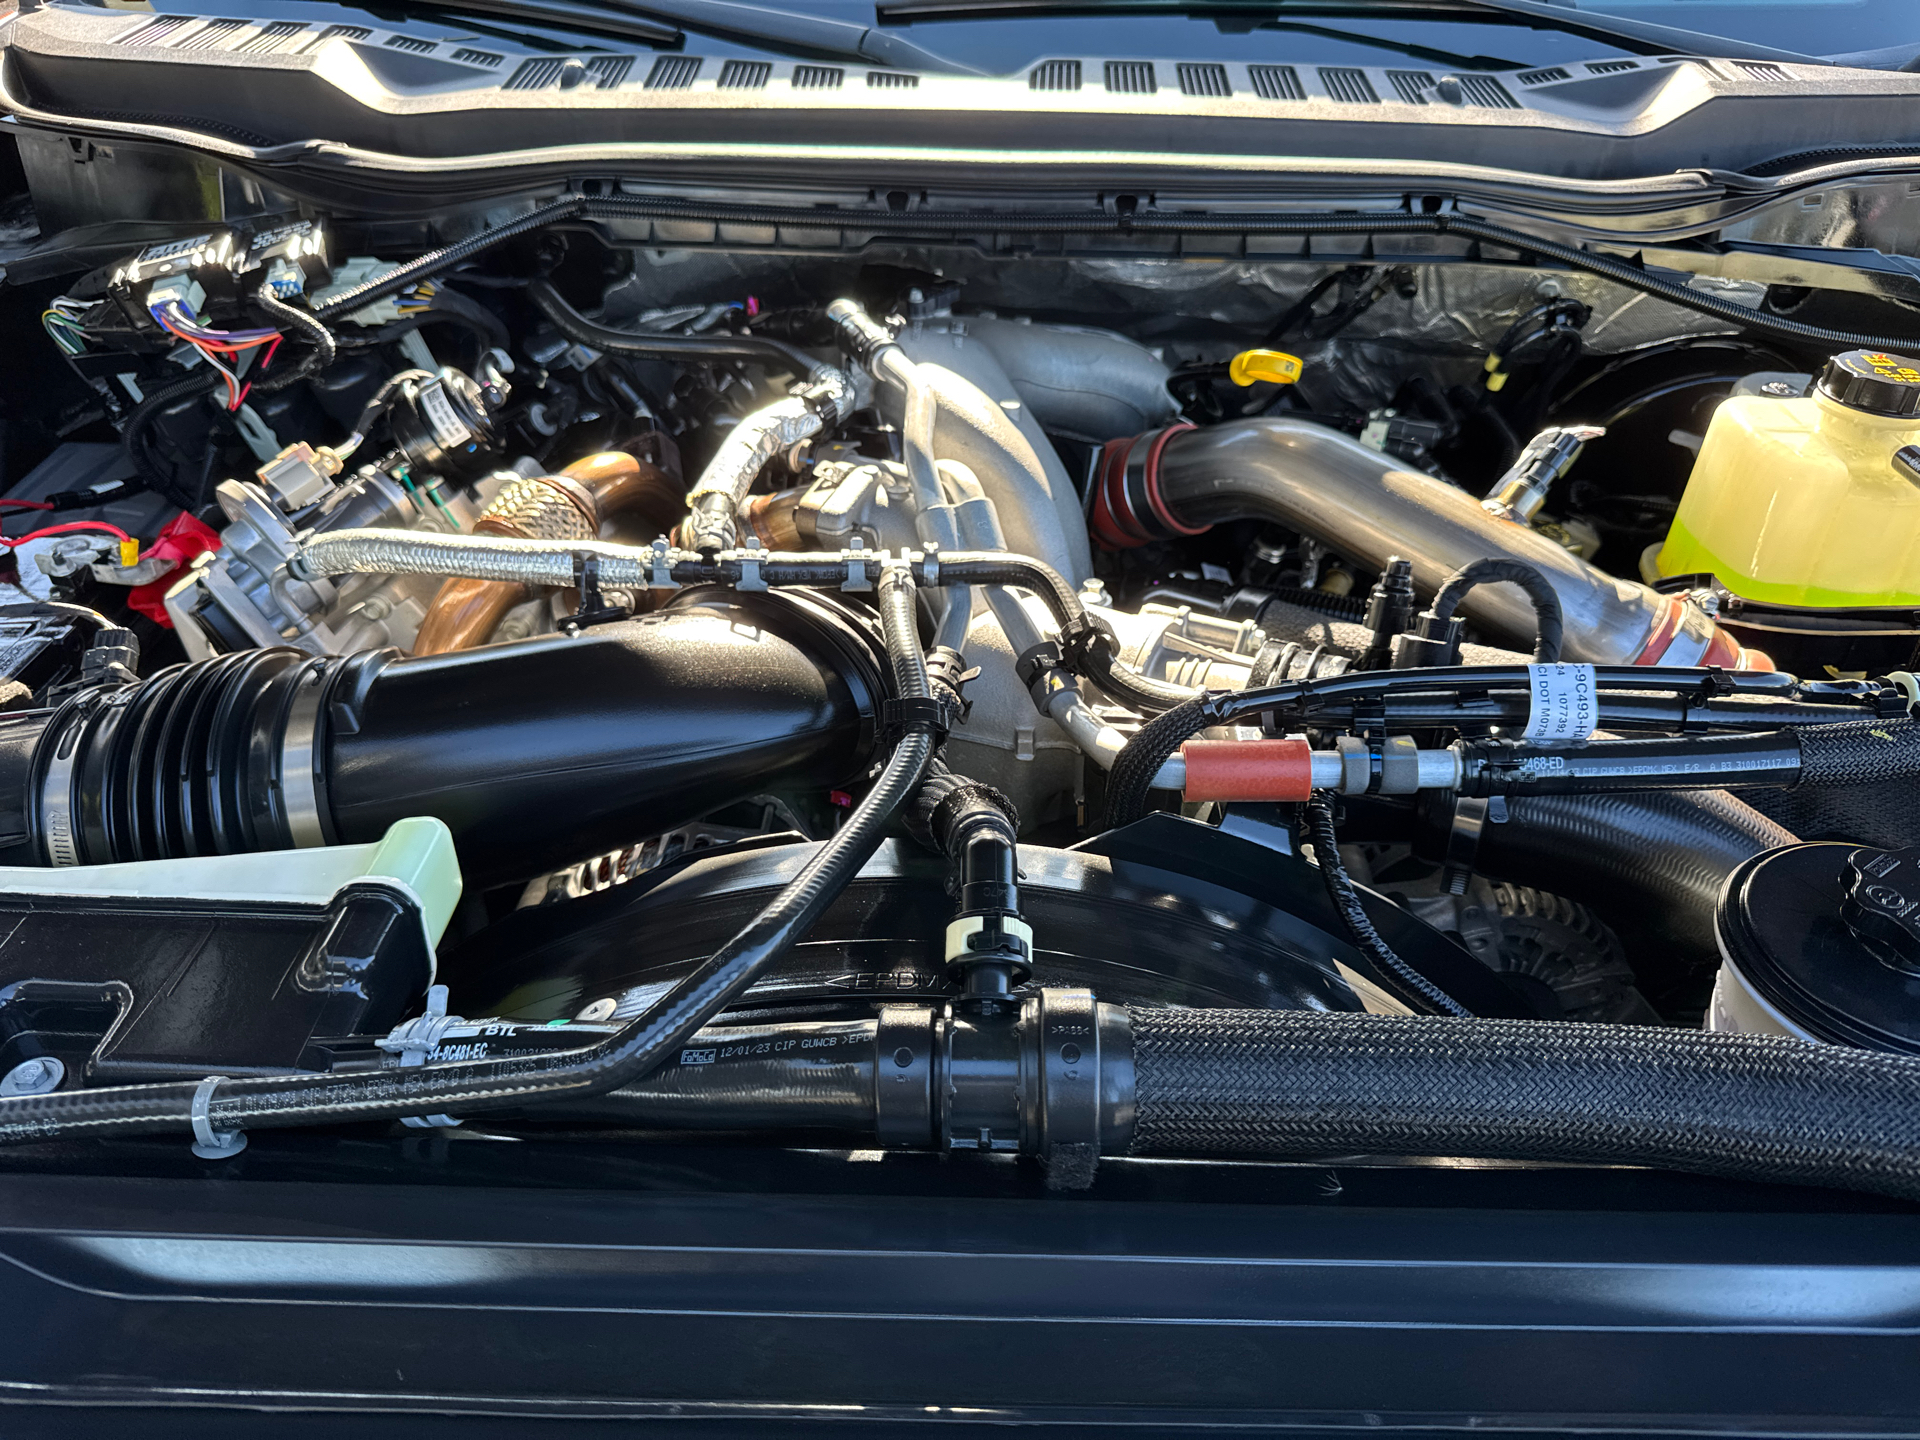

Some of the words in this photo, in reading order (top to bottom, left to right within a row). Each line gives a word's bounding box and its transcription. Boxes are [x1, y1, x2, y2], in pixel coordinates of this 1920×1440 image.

[1539, 681, 1550, 705] DOT
[1555, 691, 1569, 734] 1077392
[484, 1025, 517, 1037] BTL
[720, 1042, 771, 1058] 12/01/23
[774, 1039, 797, 1051] CIP
